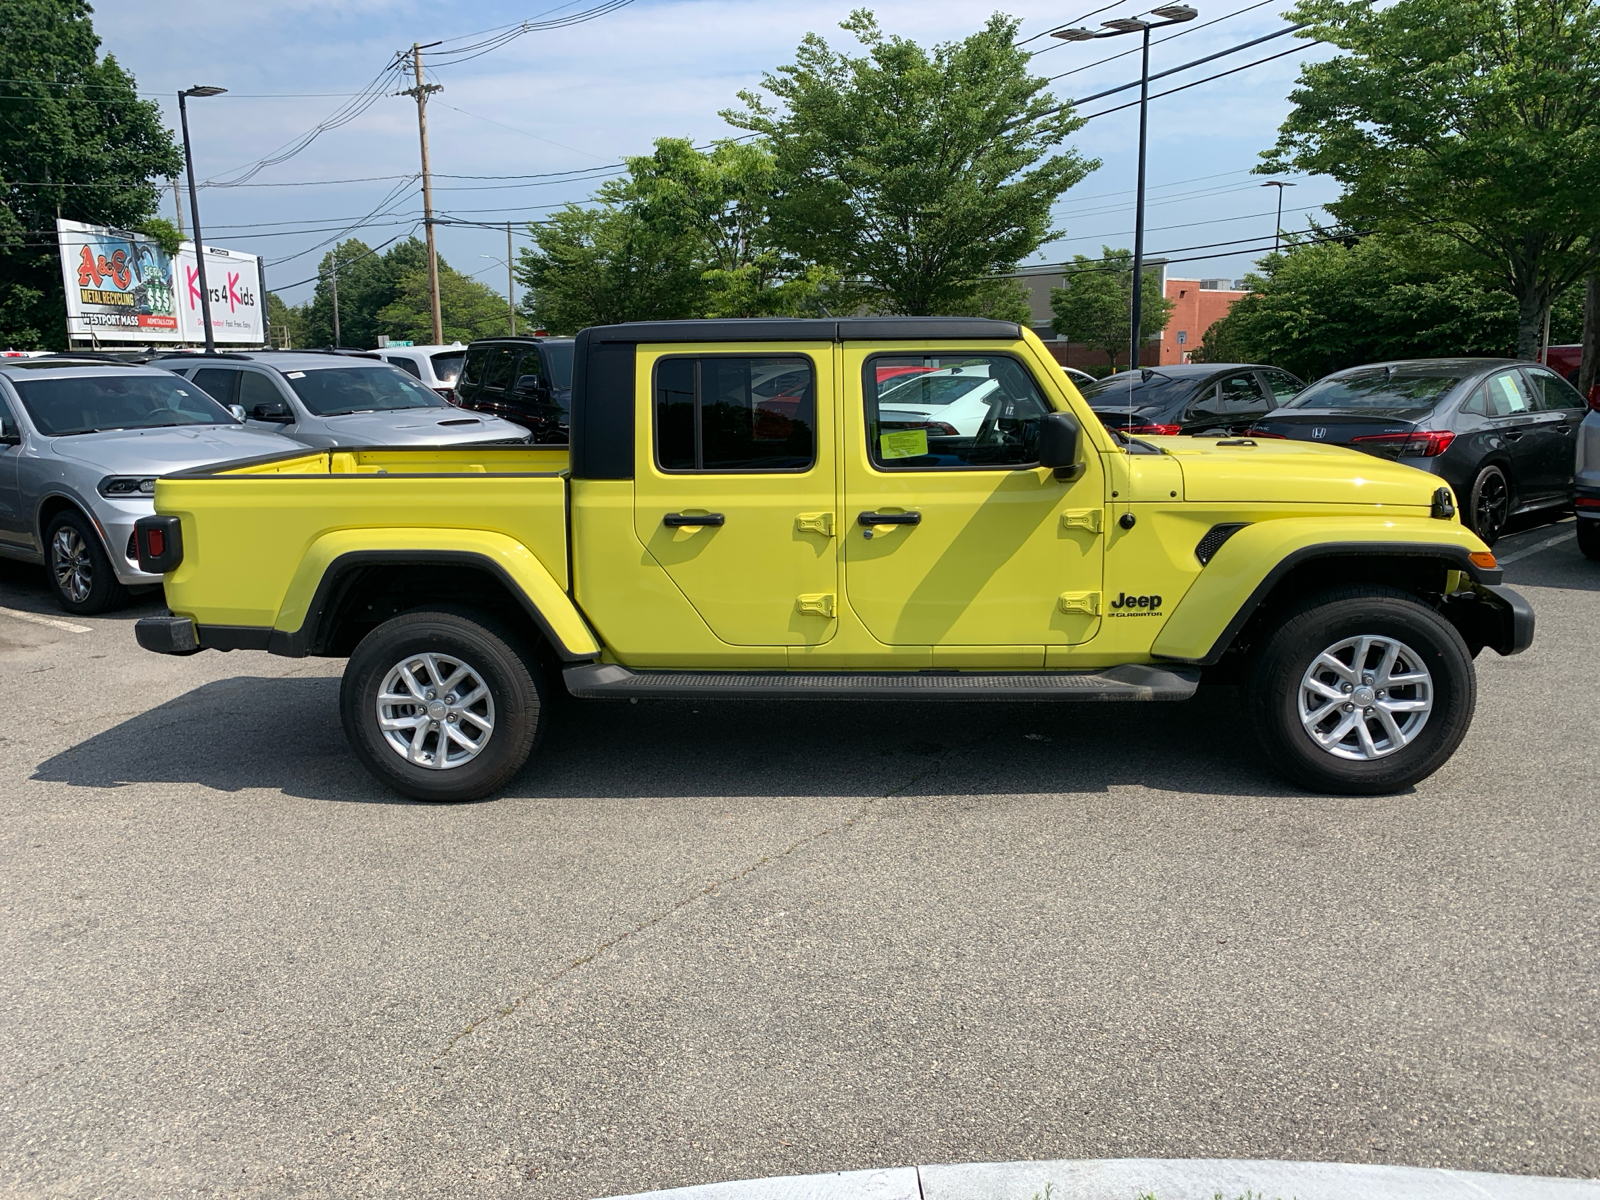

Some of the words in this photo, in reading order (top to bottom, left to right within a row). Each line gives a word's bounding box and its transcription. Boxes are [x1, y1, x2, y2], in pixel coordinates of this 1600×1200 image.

[77, 244, 132, 290] A&E
[144, 265, 167, 277] SCRAP
[81, 289, 102, 303] METAL
[102, 291, 135, 306] RECYCLING
[82, 312, 120, 326] WESTPORT
[121, 314, 139, 326] MASS
[1111, 592, 1162, 610] Jeep
